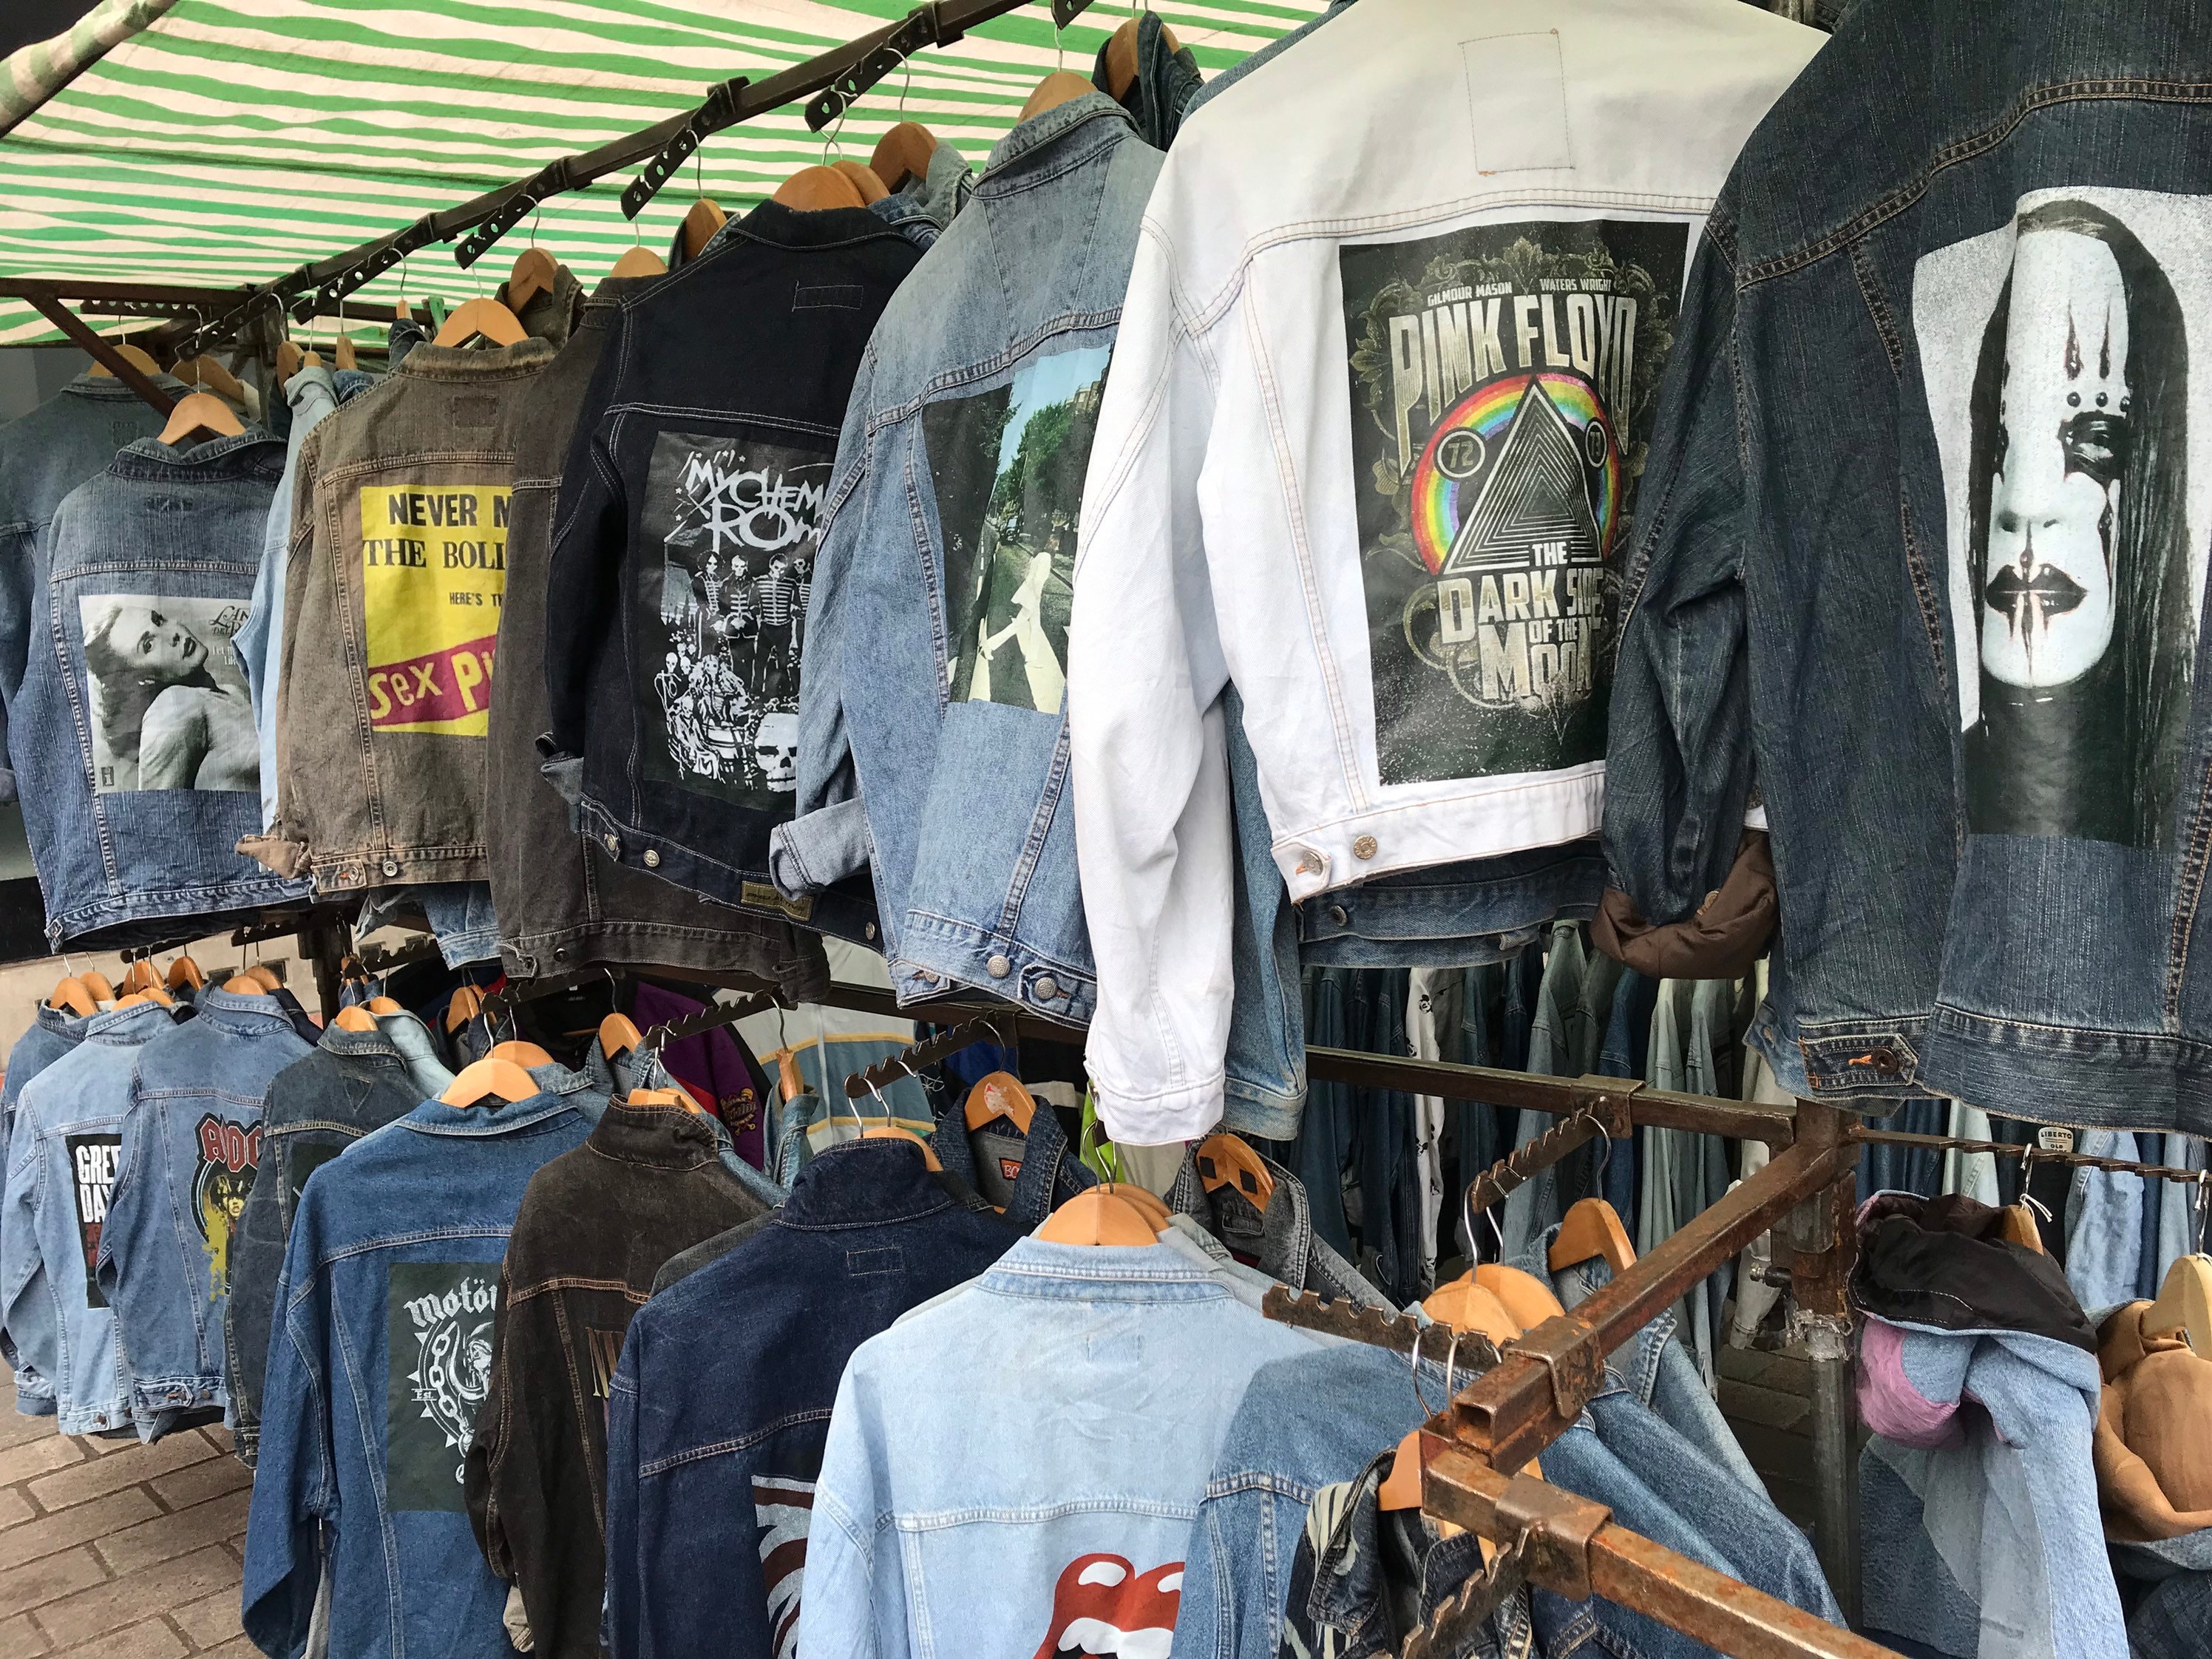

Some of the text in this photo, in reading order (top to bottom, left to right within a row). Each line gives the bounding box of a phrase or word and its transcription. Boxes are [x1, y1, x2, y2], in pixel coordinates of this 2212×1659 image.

[1428, 282, 1513, 307] GILMOUR MASON
[1539, 278, 1612, 292] WATERS WRIGHT
[1389, 294, 1637, 478] PINK FLOYD
[1448, 440, 1474, 469] 72
[389, 492, 478, 527] NEVER
[363, 539, 427, 568] THE
[1532, 542, 1567, 566] THE
[449, 592, 483, 606] HERE'S
[1437, 567, 1603, 643] DARK SIDE
[1528, 617, 1578, 644] OF THE
[1479, 617, 1592, 702] MOON
[2040, 1131, 2072, 1139] LIBERTO
